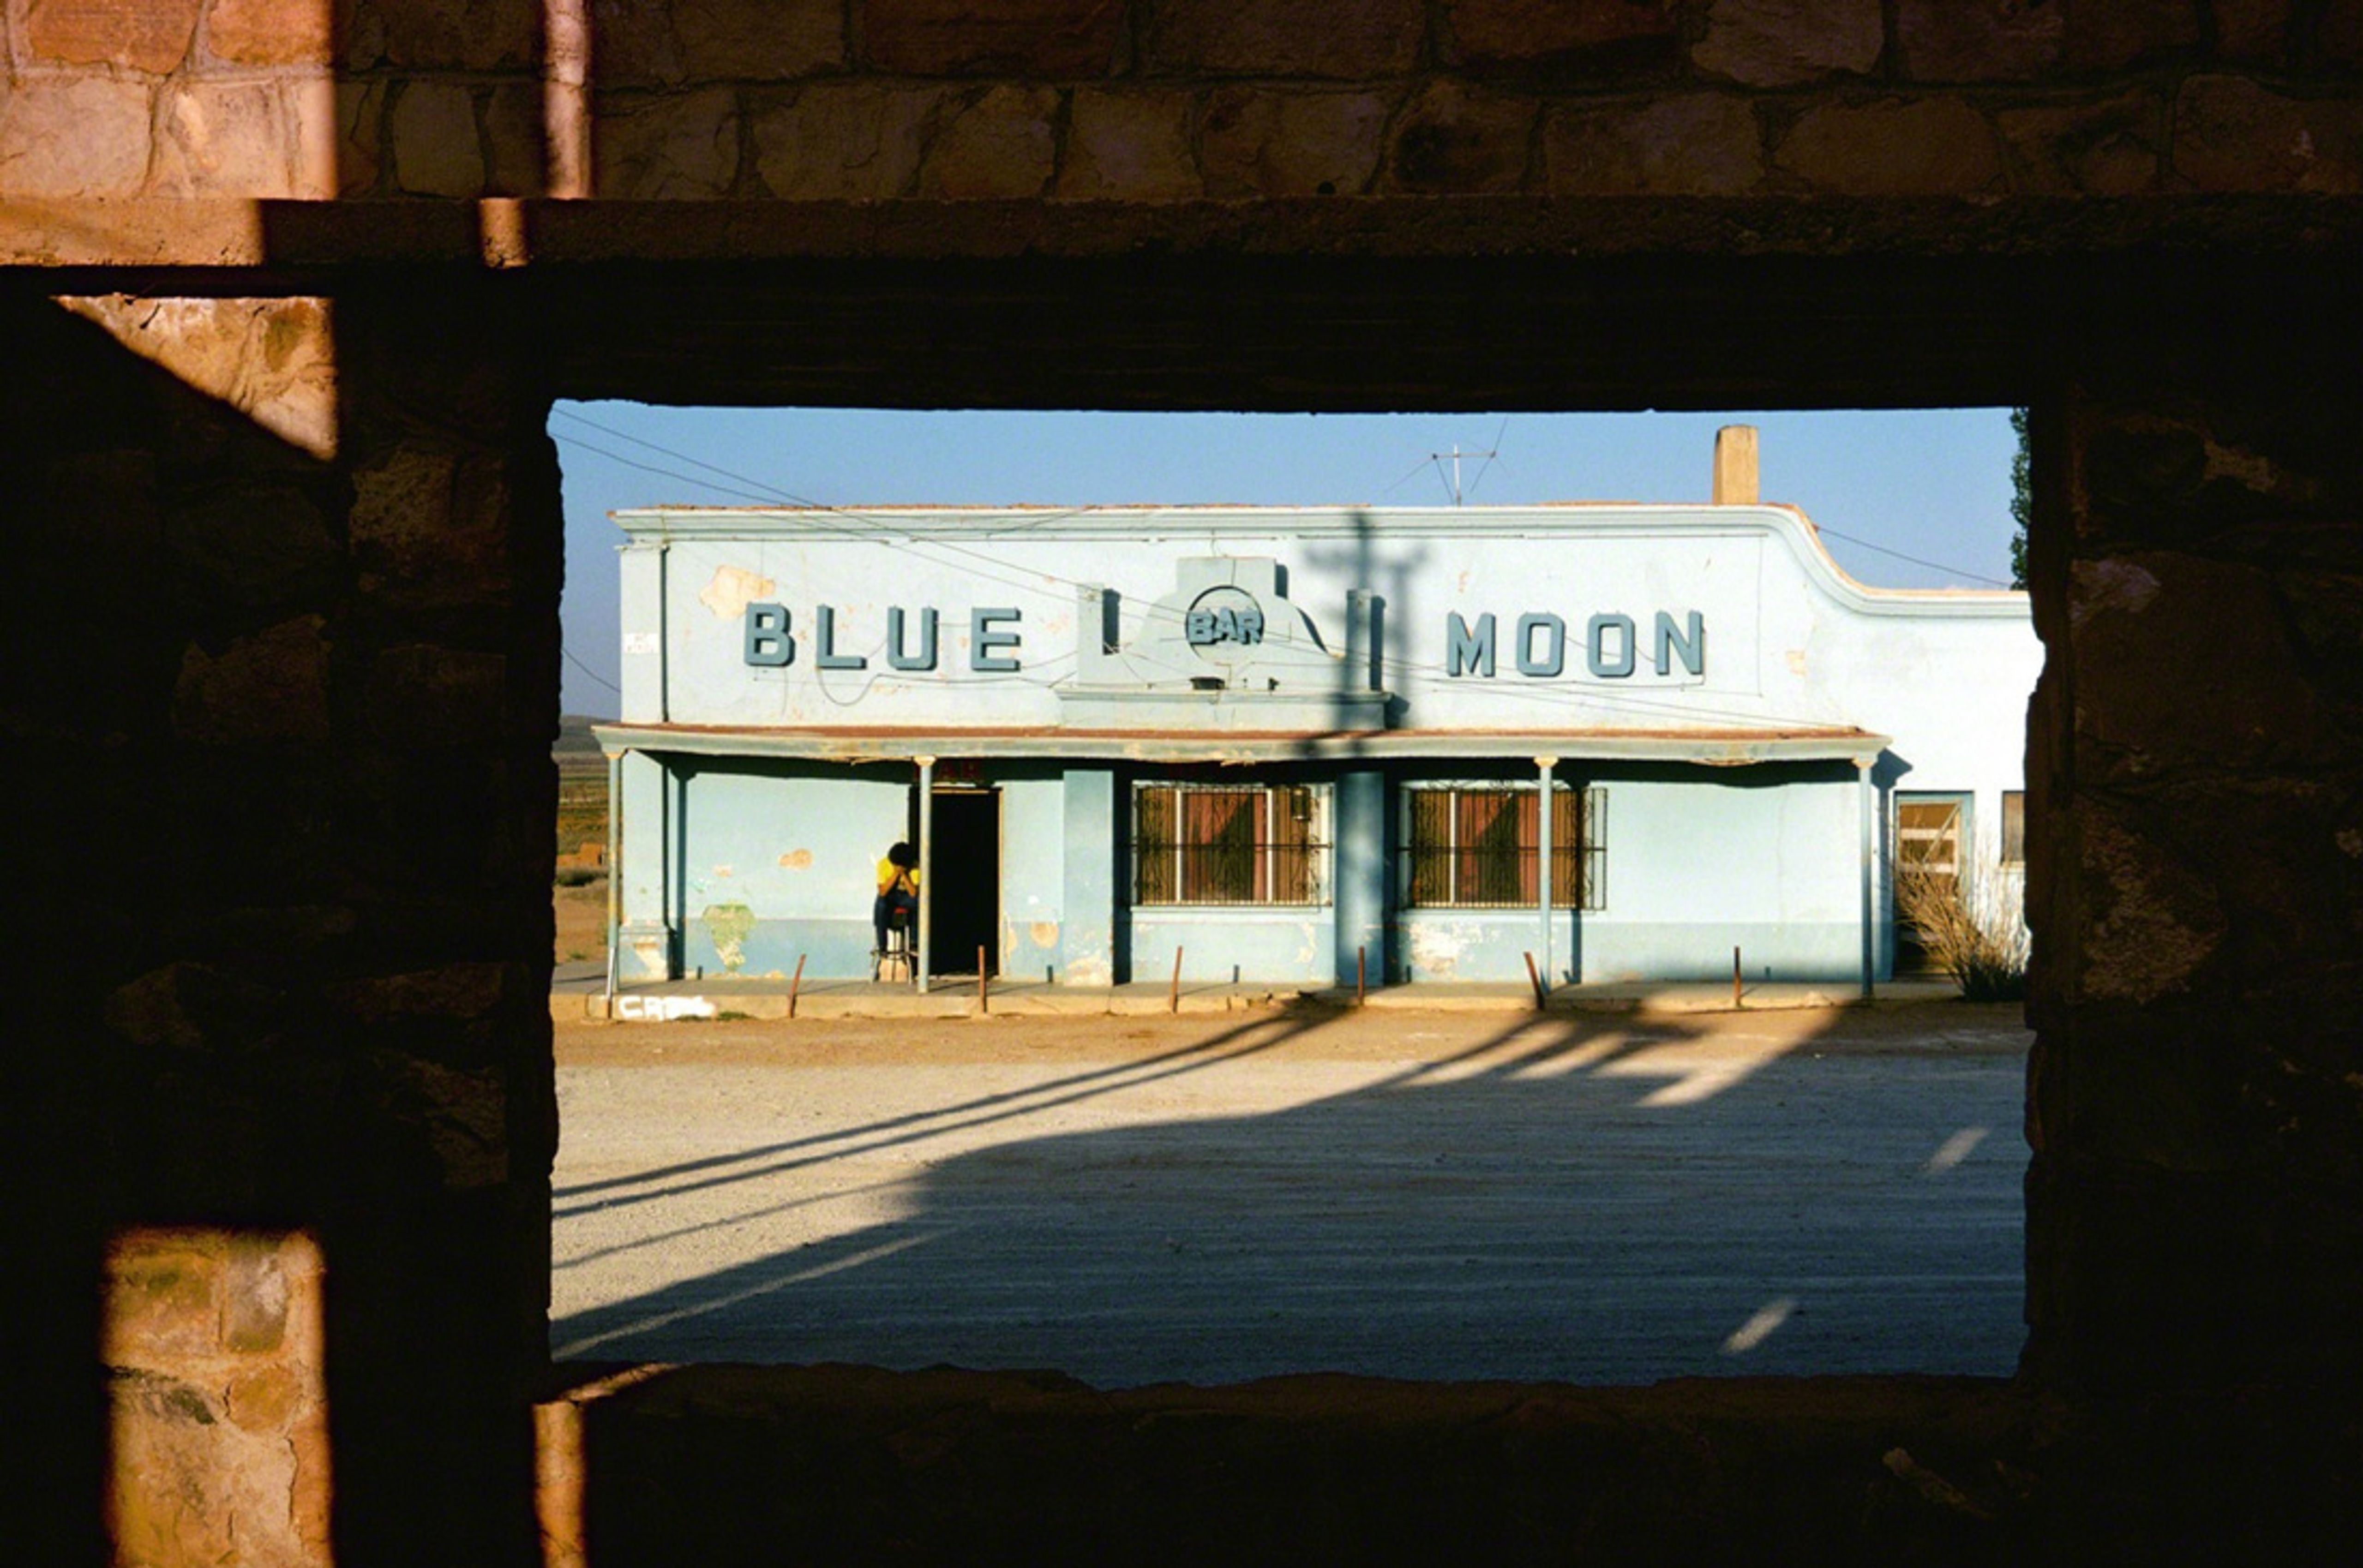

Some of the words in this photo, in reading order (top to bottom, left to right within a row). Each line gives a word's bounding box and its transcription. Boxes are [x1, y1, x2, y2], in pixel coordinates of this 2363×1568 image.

[744, 602, 1021, 671] BLUE
[1446, 611, 1703, 677] MOON
[1187, 607, 1264, 645] BAR
